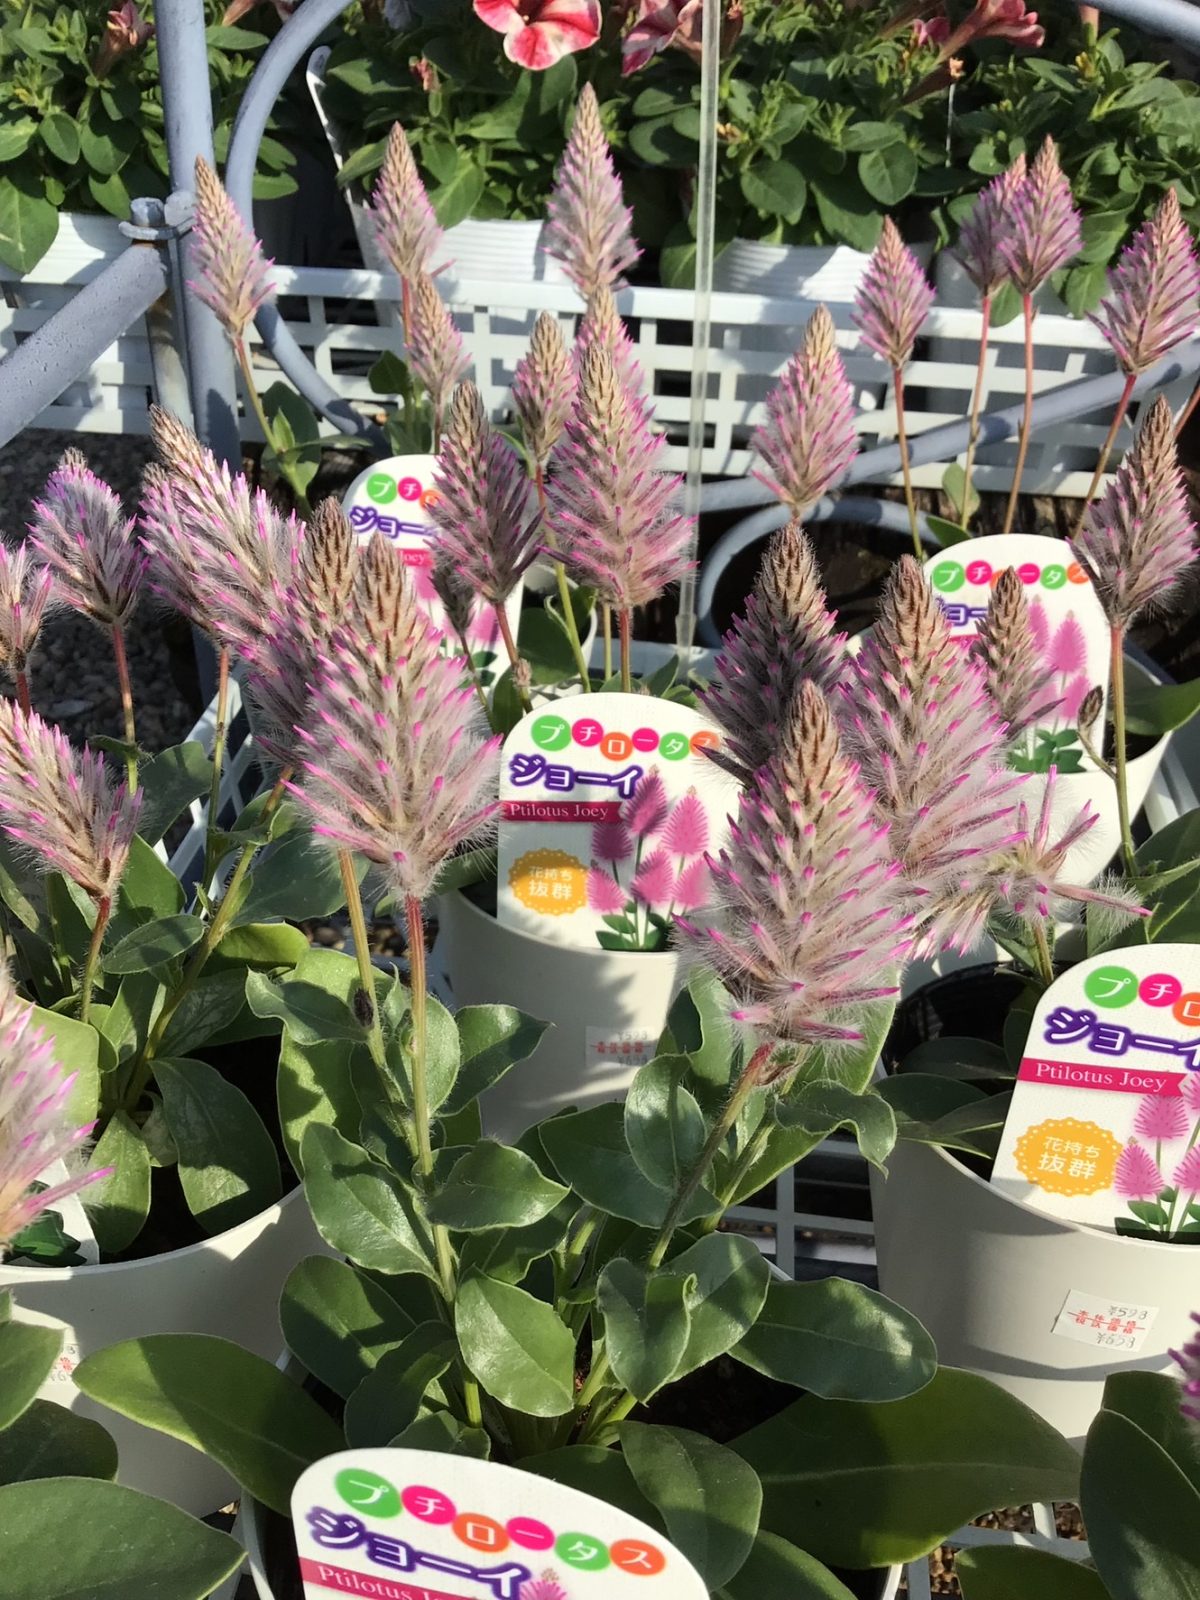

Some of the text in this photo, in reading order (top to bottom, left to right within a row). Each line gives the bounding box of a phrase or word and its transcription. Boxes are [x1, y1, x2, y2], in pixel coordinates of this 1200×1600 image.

[350, 506, 438, 538] ジョー
[936, 563, 1089, 589] プチータス
[510, 755, 643, 798] ジョーイ
[510, 802, 609, 820] Ptilotus Joey
[528, 881, 573, 900] 抜群
[1035, 1063, 1167, 1093] Ptilotus Joey
[1042, 1135, 1101, 1159] 花持ち
[1038, 1152, 1097, 1180] 抜群
[343, 1475, 659, 1572] プチロータス
[306, 1506, 532, 1600] ジョーイ
[317, 1565, 412, 1600] Ptilotus
